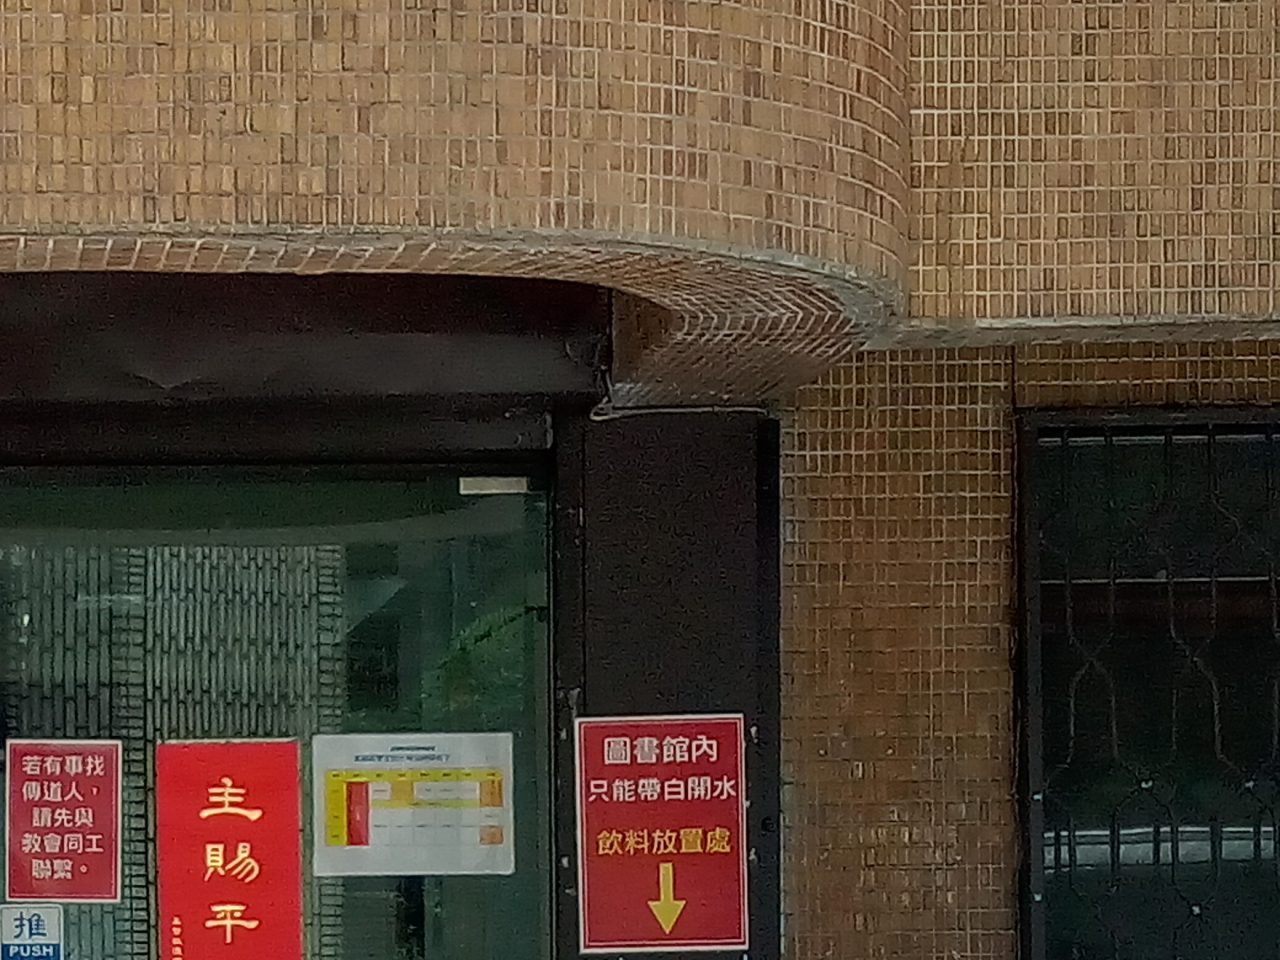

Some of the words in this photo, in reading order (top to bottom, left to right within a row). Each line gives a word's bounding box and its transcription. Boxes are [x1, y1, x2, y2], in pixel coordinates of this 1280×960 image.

[604, 736, 718, 765] 圖書館內
[21, 754, 105, 777] 若有事找
[588, 775, 737, 802] 只能帶白開水
[32, 806, 94, 828] 請先與
[21, 832, 104, 854] 教會同工
[596, 827, 732, 855] 飲料放置處
[13, 911, 47, 940] 推
[8, 945, 54, 957] PUSH
